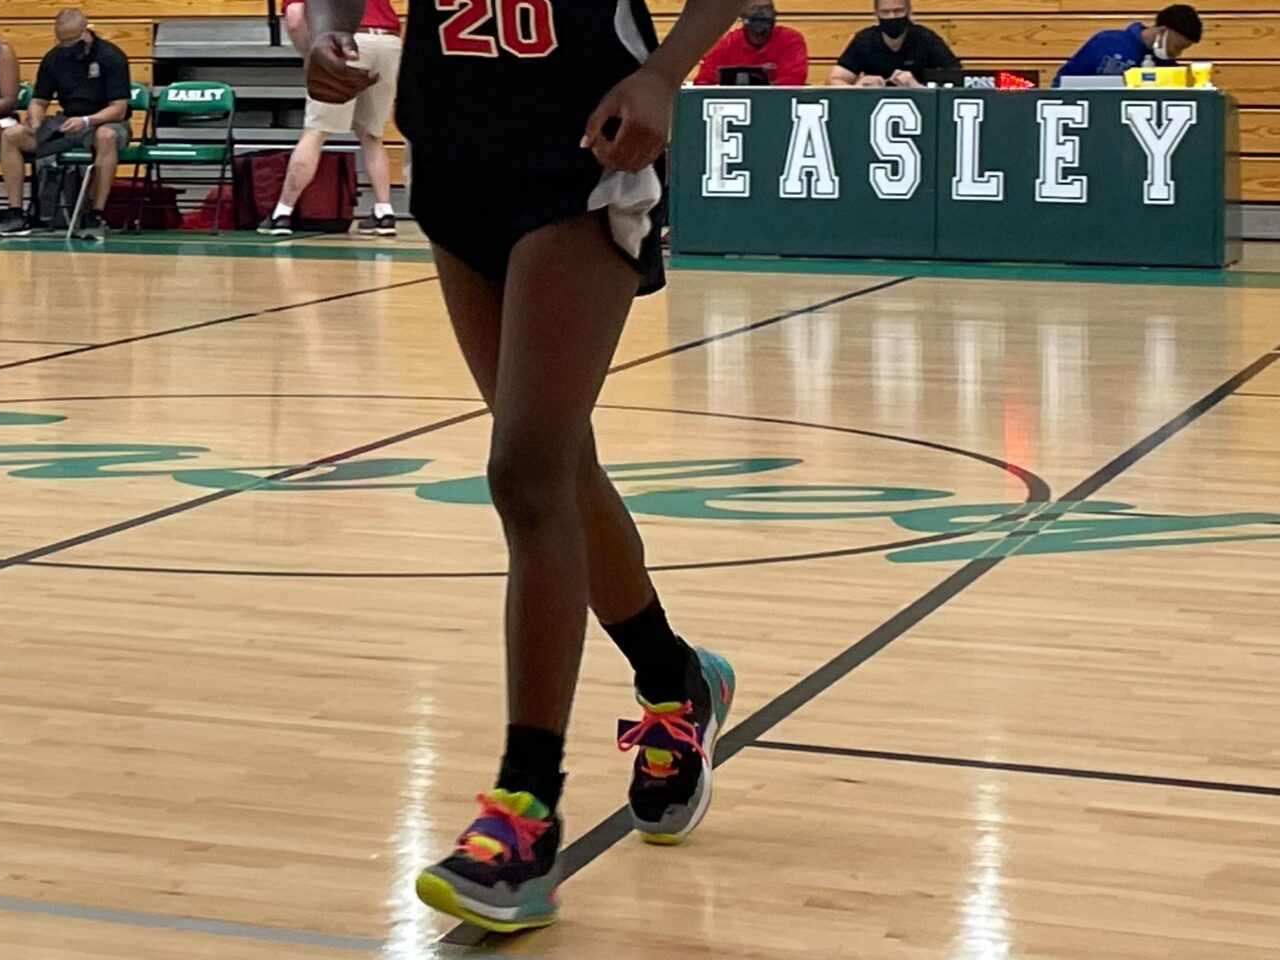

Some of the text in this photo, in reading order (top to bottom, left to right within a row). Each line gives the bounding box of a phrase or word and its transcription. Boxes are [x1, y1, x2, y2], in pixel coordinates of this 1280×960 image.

[964, 75, 995, 89] POSS
[167, 89, 225, 101] EASLEY
[702, 98, 1197, 205] EASLEY
